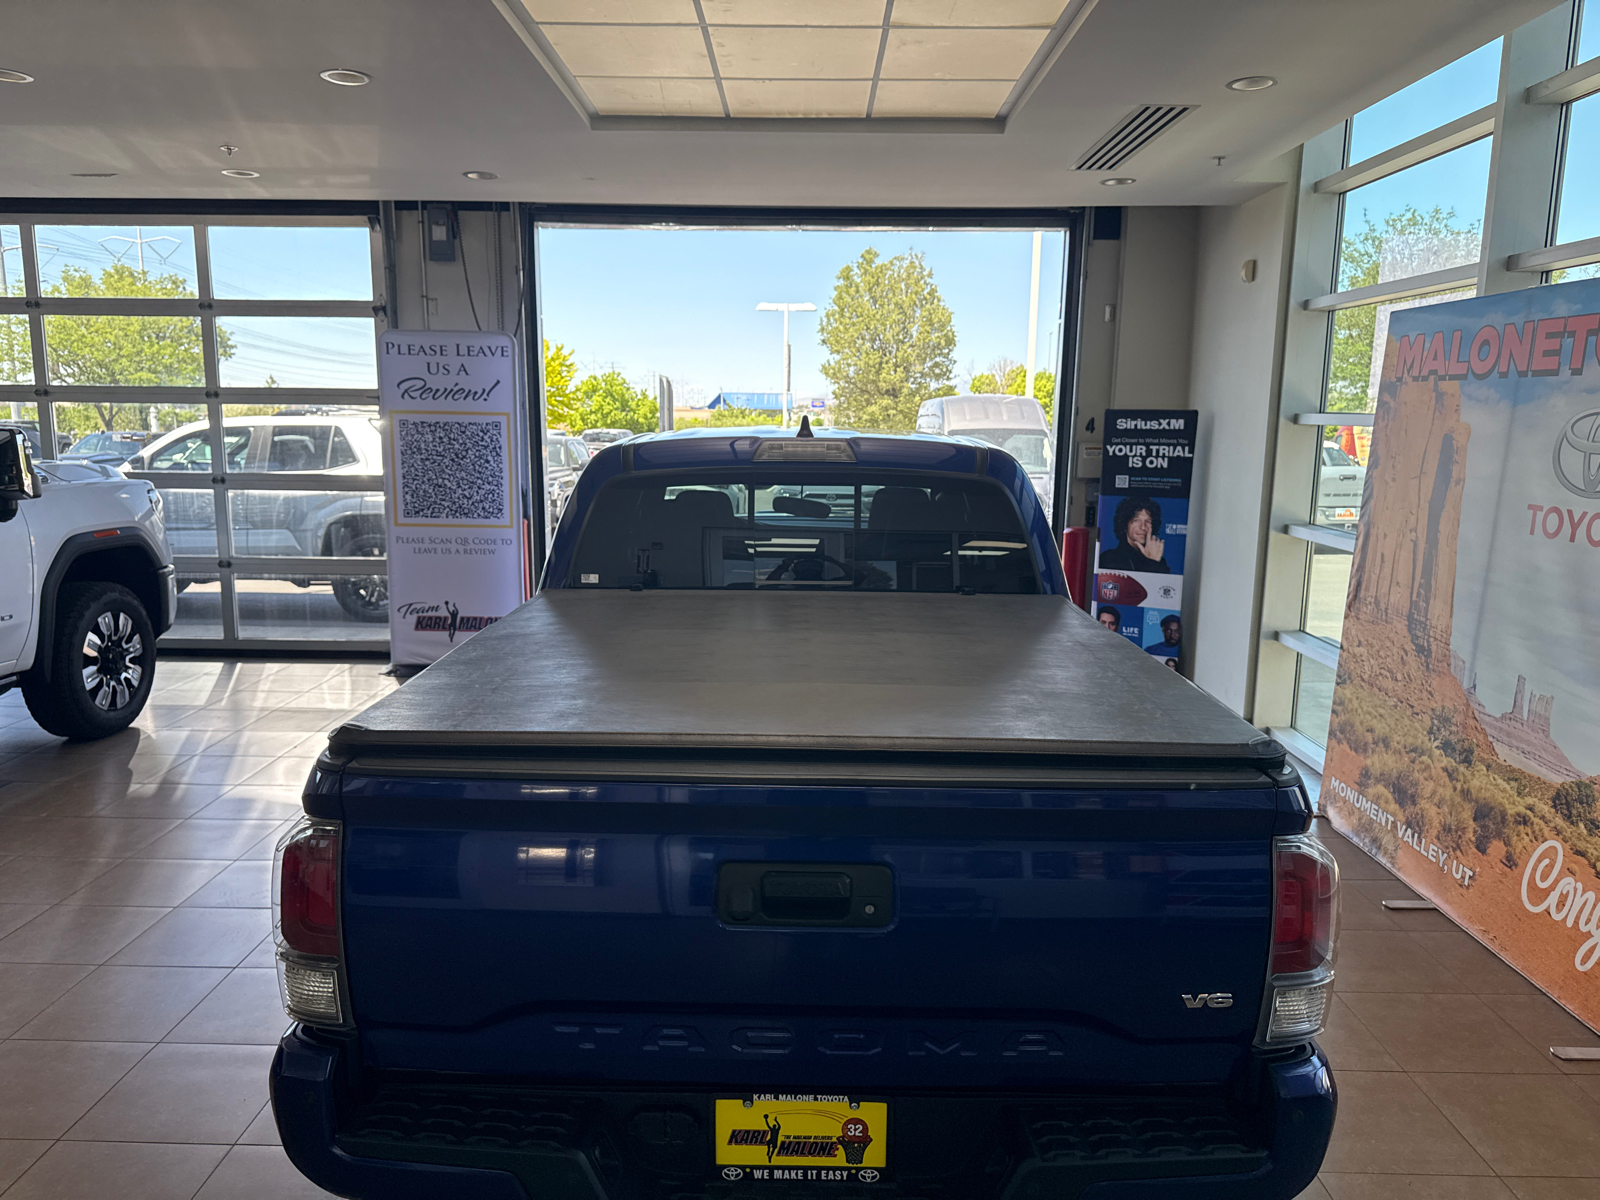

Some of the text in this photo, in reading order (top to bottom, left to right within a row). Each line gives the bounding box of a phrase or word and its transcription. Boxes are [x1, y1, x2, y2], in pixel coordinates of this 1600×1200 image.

[385, 341, 509, 358] PLEASE LEAVE
[1395, 312, 1600, 383] MALONET
[426, 361, 470, 376] US A
[396, 377, 501, 402] Review!
[1085, 416, 1096, 434] 4
[1116, 418, 1185, 430] SiriusXM
[1106, 445, 1146, 456] YOUR
[1149, 446, 1193, 457] TRIAL
[1128, 456, 1168, 468] IS ON
[395, 536, 513, 546] PLEASE SCAN QR CODE TO
[413, 547, 439, 555] LEAVE
[441, 547, 452, 555] US
[463, 548, 497, 556] REVIEW
[1102, 589, 1116, 599] NFL
[397, 601, 442, 619] Team
[414, 615, 449, 632] KARL
[1330, 776, 1473, 886] MONUMENT VALLEY, UT
[1181, 993, 1234, 1009] V6
[552, 1024, 1064, 1056] TACOMA
[753, 1093, 849, 1103] KARL MALONE TOYOTA
[728, 1130, 769, 1145] KARL
[847, 1124, 863, 1136] 32
[776, 1141, 840, 1157] MALONE
[753, 1169, 848, 1180] WE MAKE IT EASY
